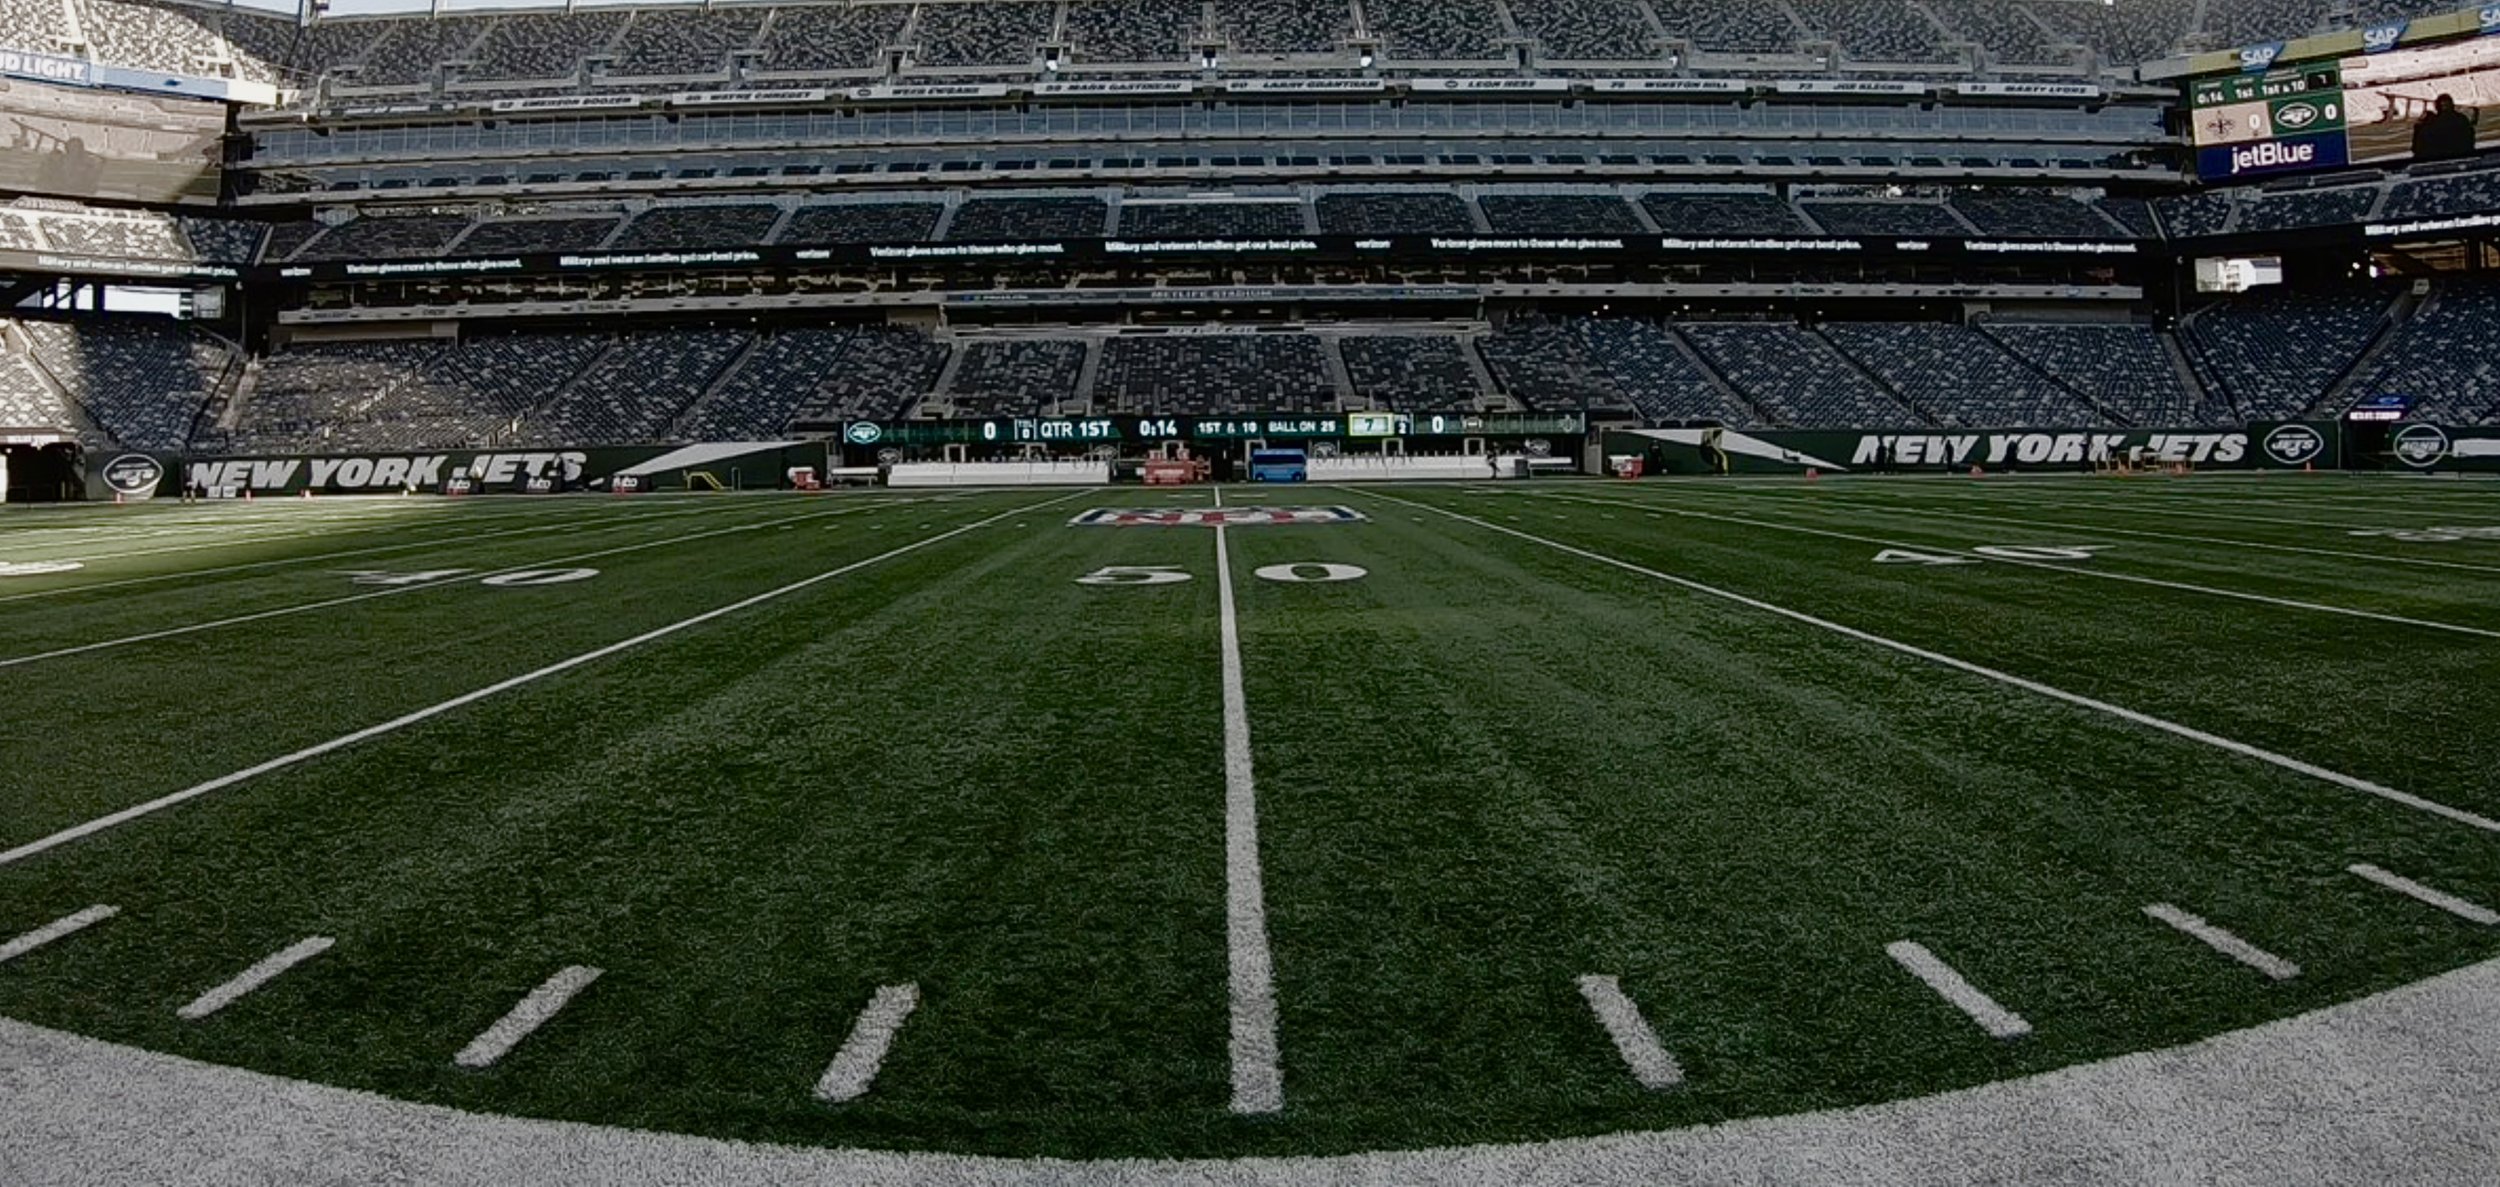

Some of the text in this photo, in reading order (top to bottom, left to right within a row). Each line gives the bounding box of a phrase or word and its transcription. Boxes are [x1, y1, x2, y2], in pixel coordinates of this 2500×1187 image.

[2480, 9, 2500, 27] SA
[2363, 28, 2398, 47] SAP
[2240, 47, 2274, 67] SAP
[22, 57, 84, 80] LIGHT
[2235, 88, 2254, 99] 1st
[2262, 84, 2280, 96] 1st
[2291, 80, 2306, 92] 10
[2197, 91, 2225, 104] 0:14
[2324, 104, 2337, 120] 0
[2249, 114, 2261, 129] 0
[2231, 141, 2313, 174] jetBlue
[983, 421, 996, 440] 0
[1041, 421, 1111, 438] QTR 1ST
[1139, 419, 1178, 437] 0:14
[1198, 421, 1222, 434] 1ST
[1242, 421, 1257, 433] 10
[1268, 420, 1335, 432] BALL ON 25
[1364, 418, 1374, 432] 7
[1431, 415, 1444, 434] 0
[190, 458, 301, 489] NEW
[308, 455, 450, 488] YORK
